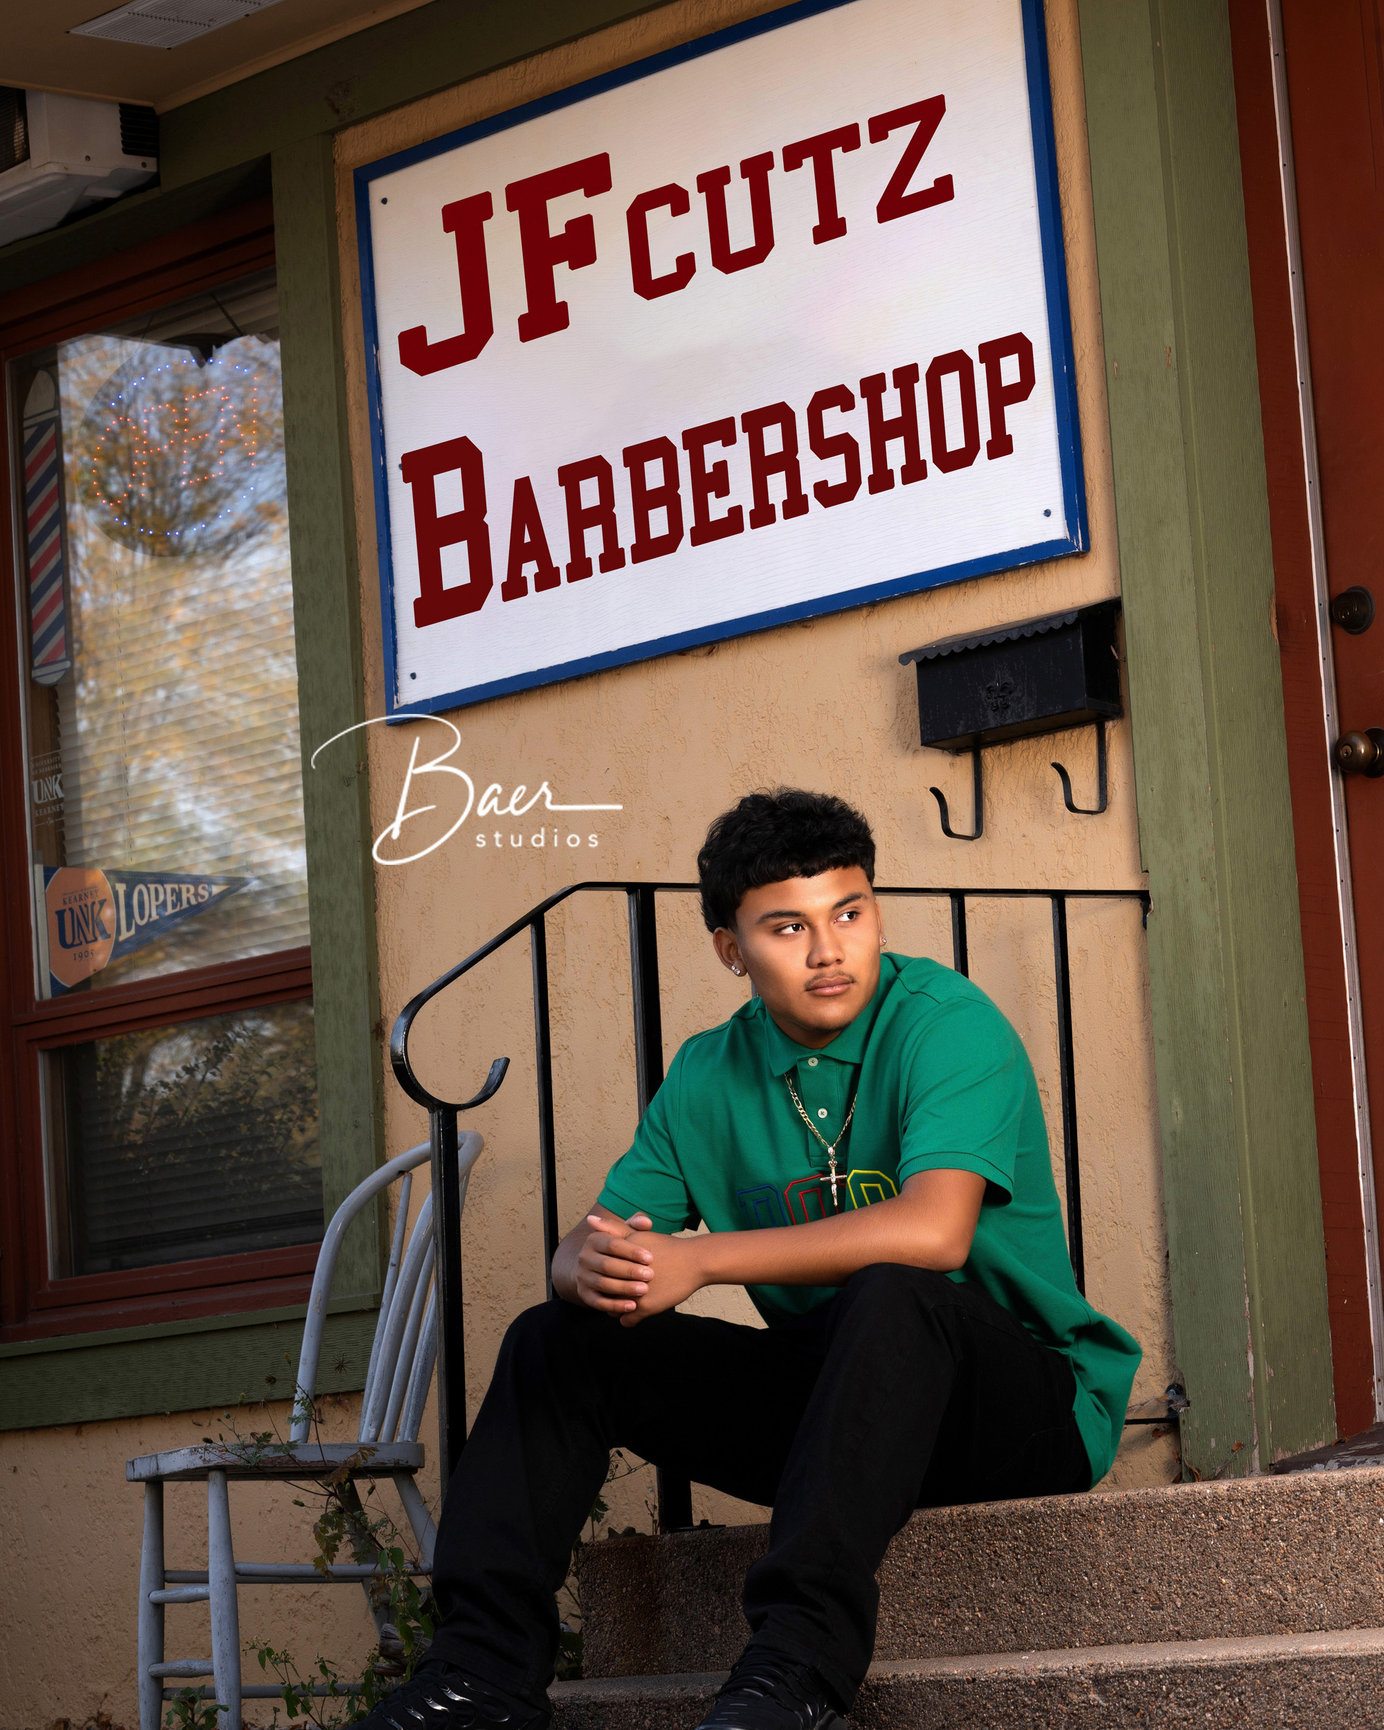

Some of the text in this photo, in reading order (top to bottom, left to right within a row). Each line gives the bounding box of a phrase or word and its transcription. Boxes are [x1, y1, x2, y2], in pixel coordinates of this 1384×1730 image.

[91, 375, 260, 507] OPEN
[32, 773, 64, 805] UNK
[62, 887, 99, 906] KEARNEY
[115, 882, 209, 943] LOPERS
[55, 898, 111, 949] UNK
